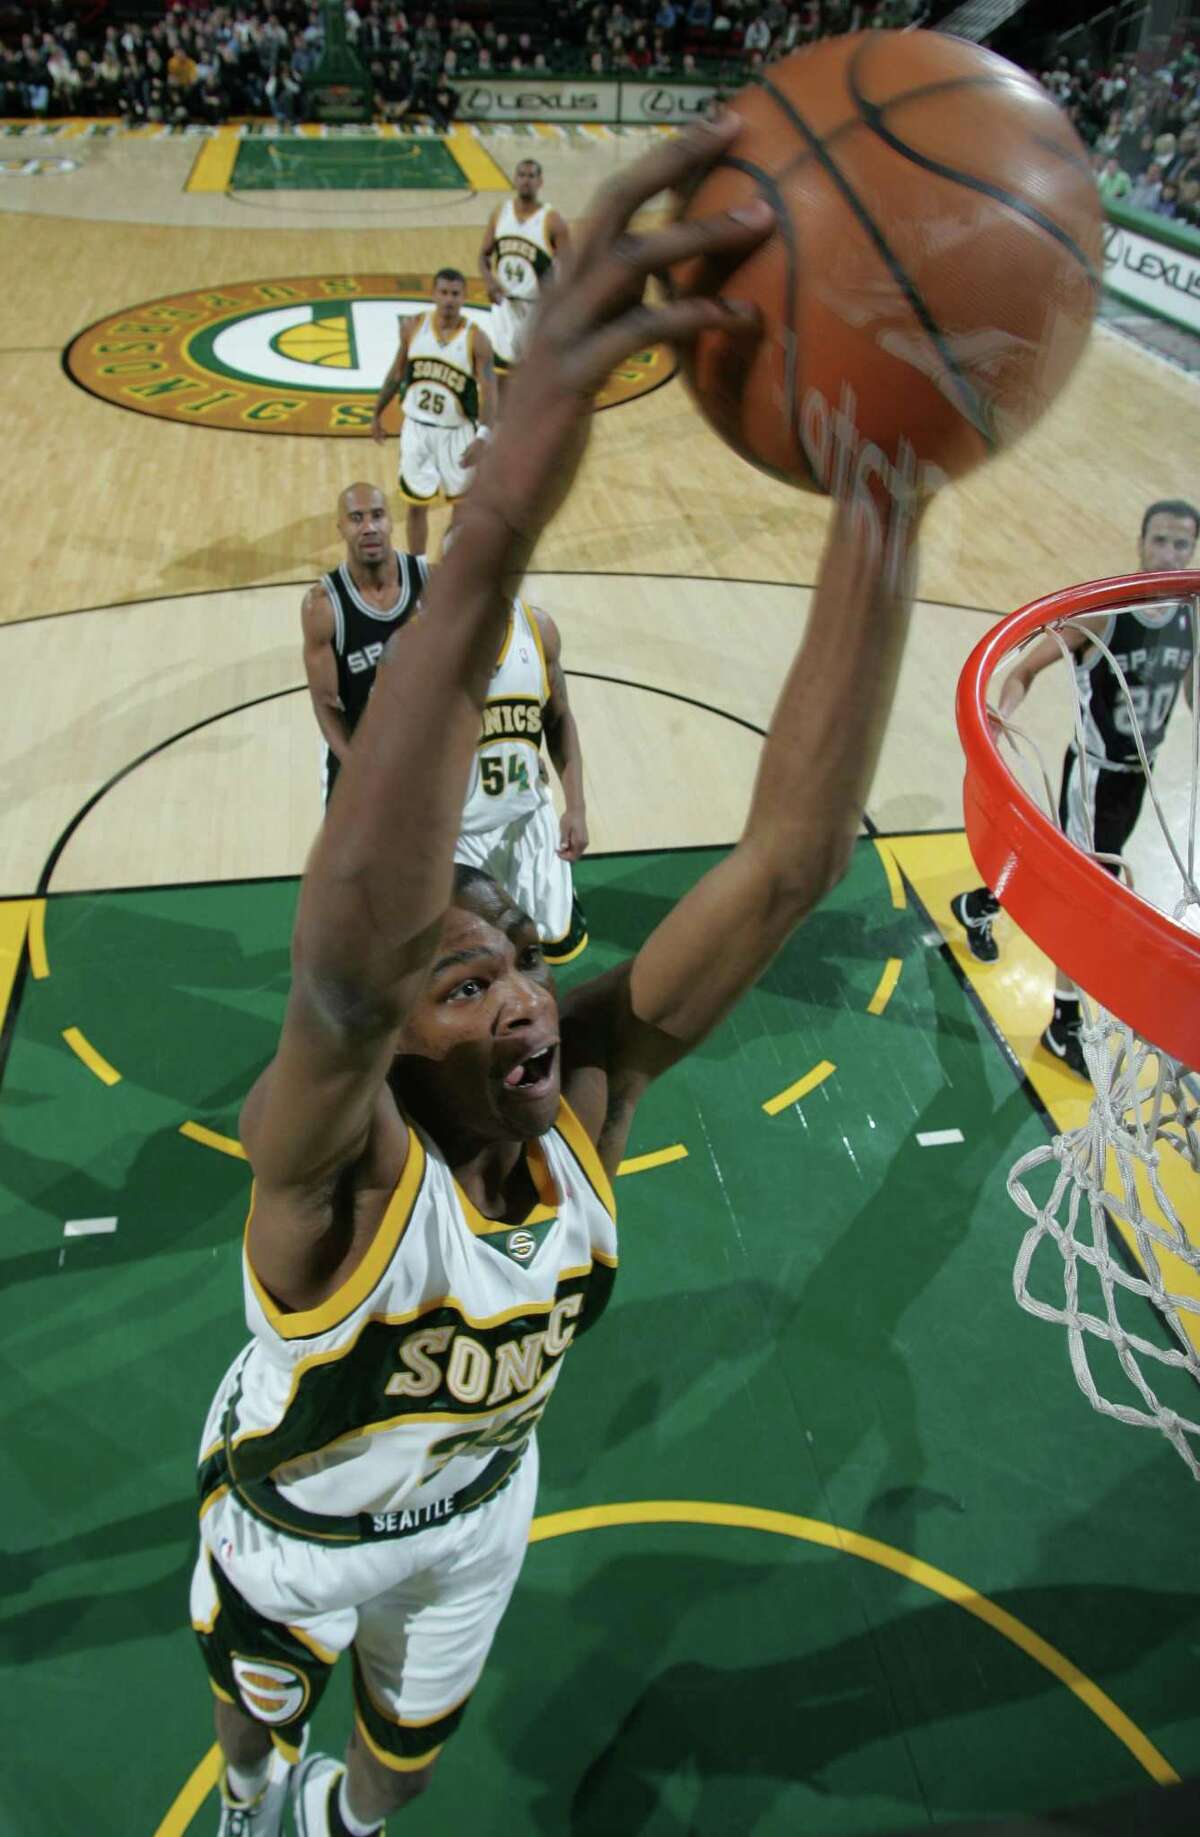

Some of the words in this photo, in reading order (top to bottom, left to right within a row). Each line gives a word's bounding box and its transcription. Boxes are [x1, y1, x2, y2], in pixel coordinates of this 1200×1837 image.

[496, 94, 597, 110] LEXUS
[505, 261, 524, 283] 44
[413, 360, 466, 392] SONICS
[418, 390, 445, 415] 25
[1110, 647, 1191, 673] SPRS
[480, 705, 542, 737] NICS
[1113, 684, 1175, 734] 20
[480, 754, 530, 796] 54
[373, 1497, 454, 1532] SEATTLE
